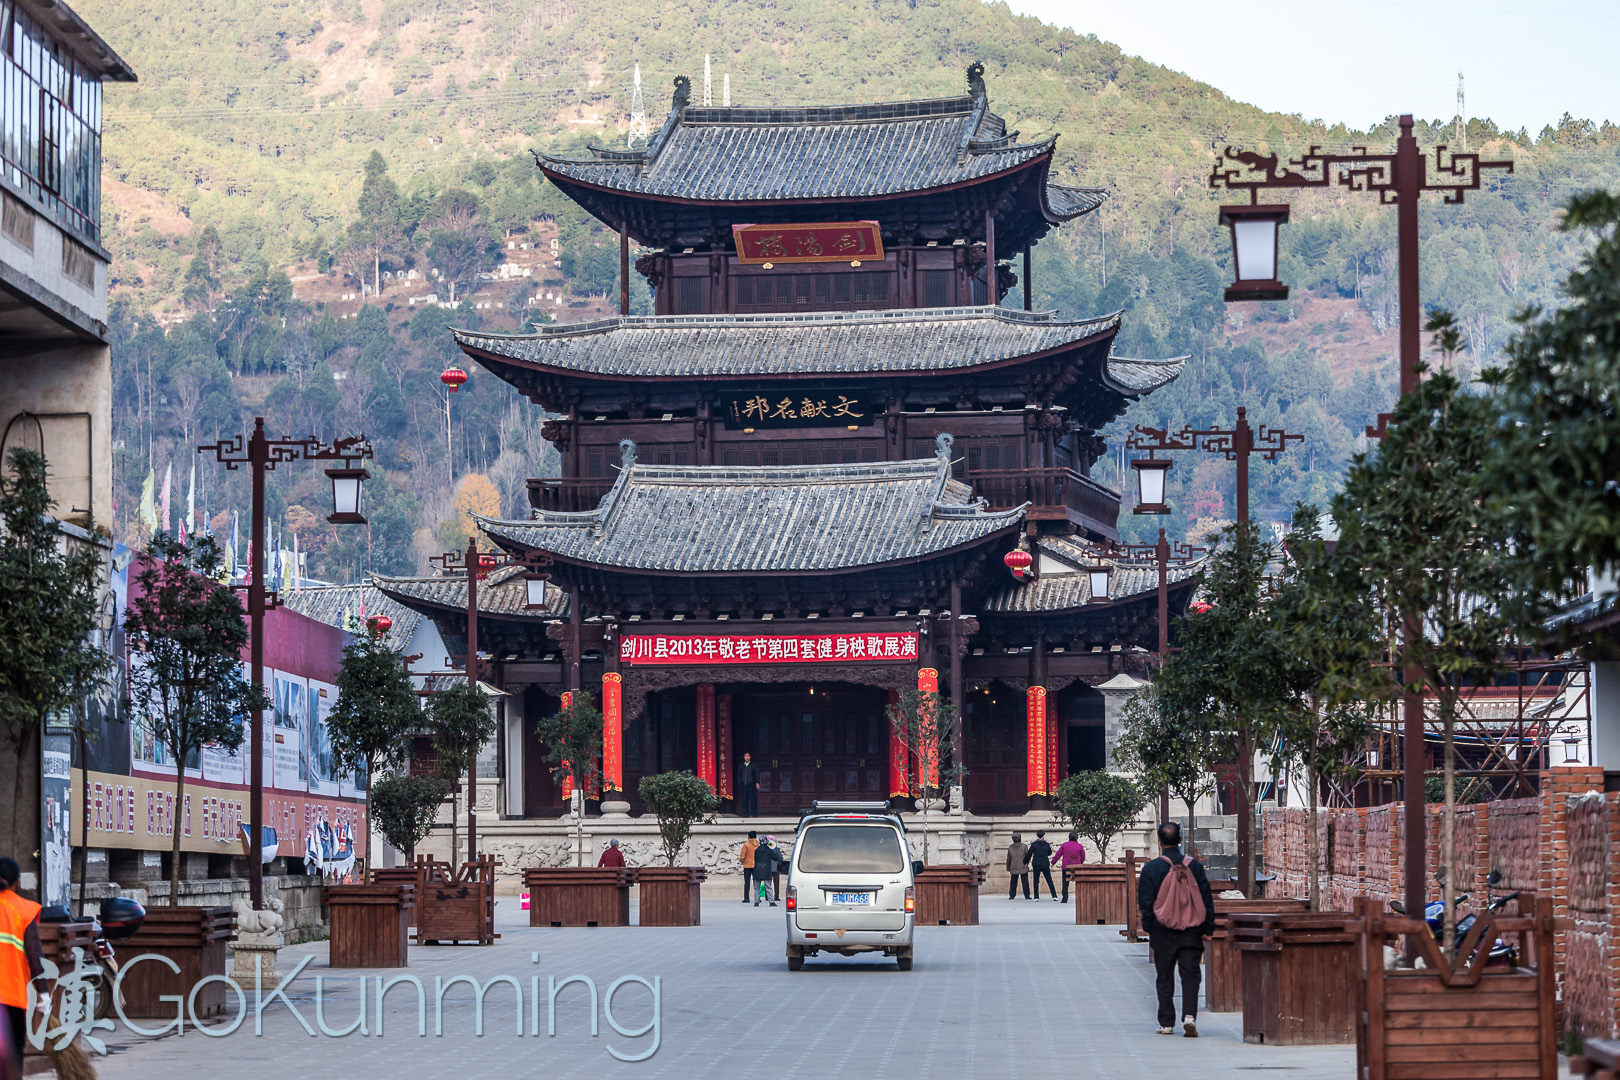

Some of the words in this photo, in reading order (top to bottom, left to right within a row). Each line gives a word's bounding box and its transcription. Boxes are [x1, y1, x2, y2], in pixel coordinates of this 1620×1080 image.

[742, 395, 864, 421] 文献名邦
[621, 635, 917, 660] 剑川县2013年敬老节第四套健身秧歌展演
